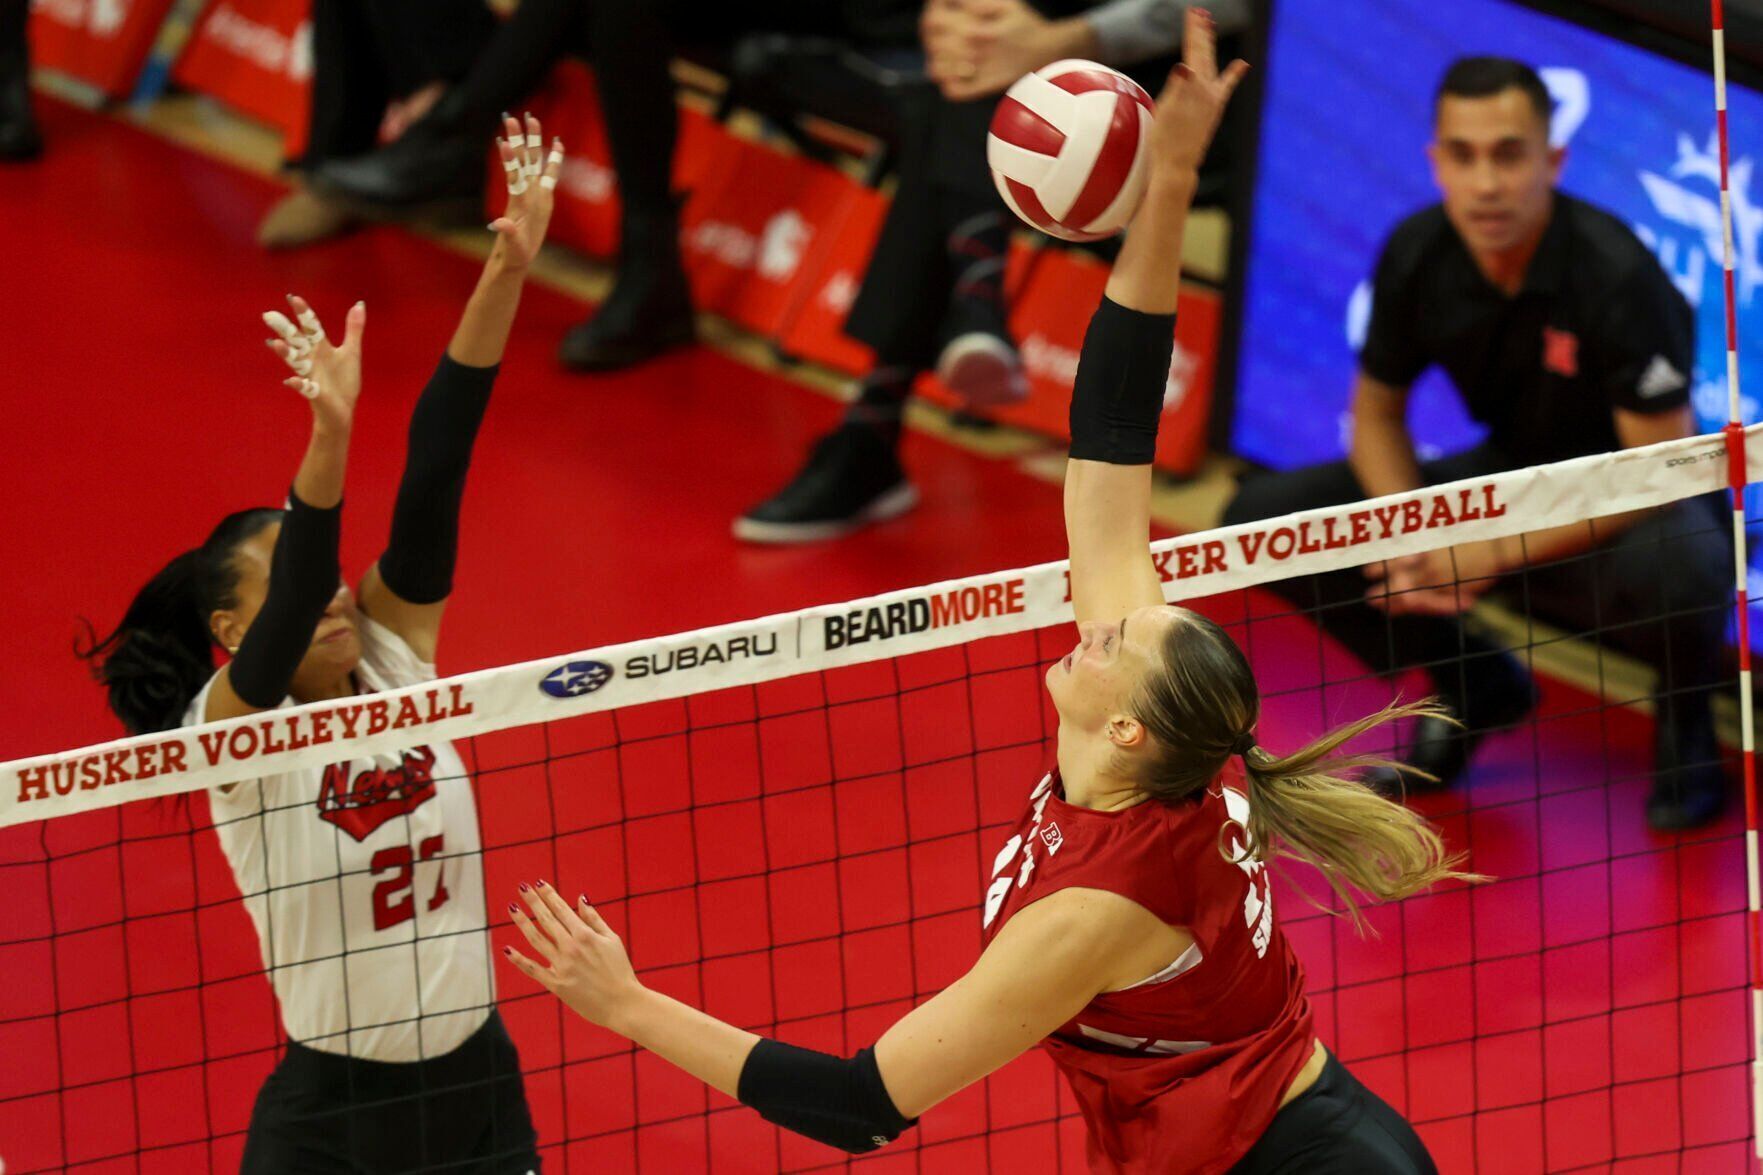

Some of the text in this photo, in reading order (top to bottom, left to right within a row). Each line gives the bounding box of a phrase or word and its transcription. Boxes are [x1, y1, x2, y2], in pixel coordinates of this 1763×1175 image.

[1238, 485, 1507, 564] VOLLEYBALL
[625, 578, 1026, 680] SUBARU BEARDMORE
[18, 685, 474, 803] HUSKER VOLLEYBALL
[370, 833, 450, 932] 27
